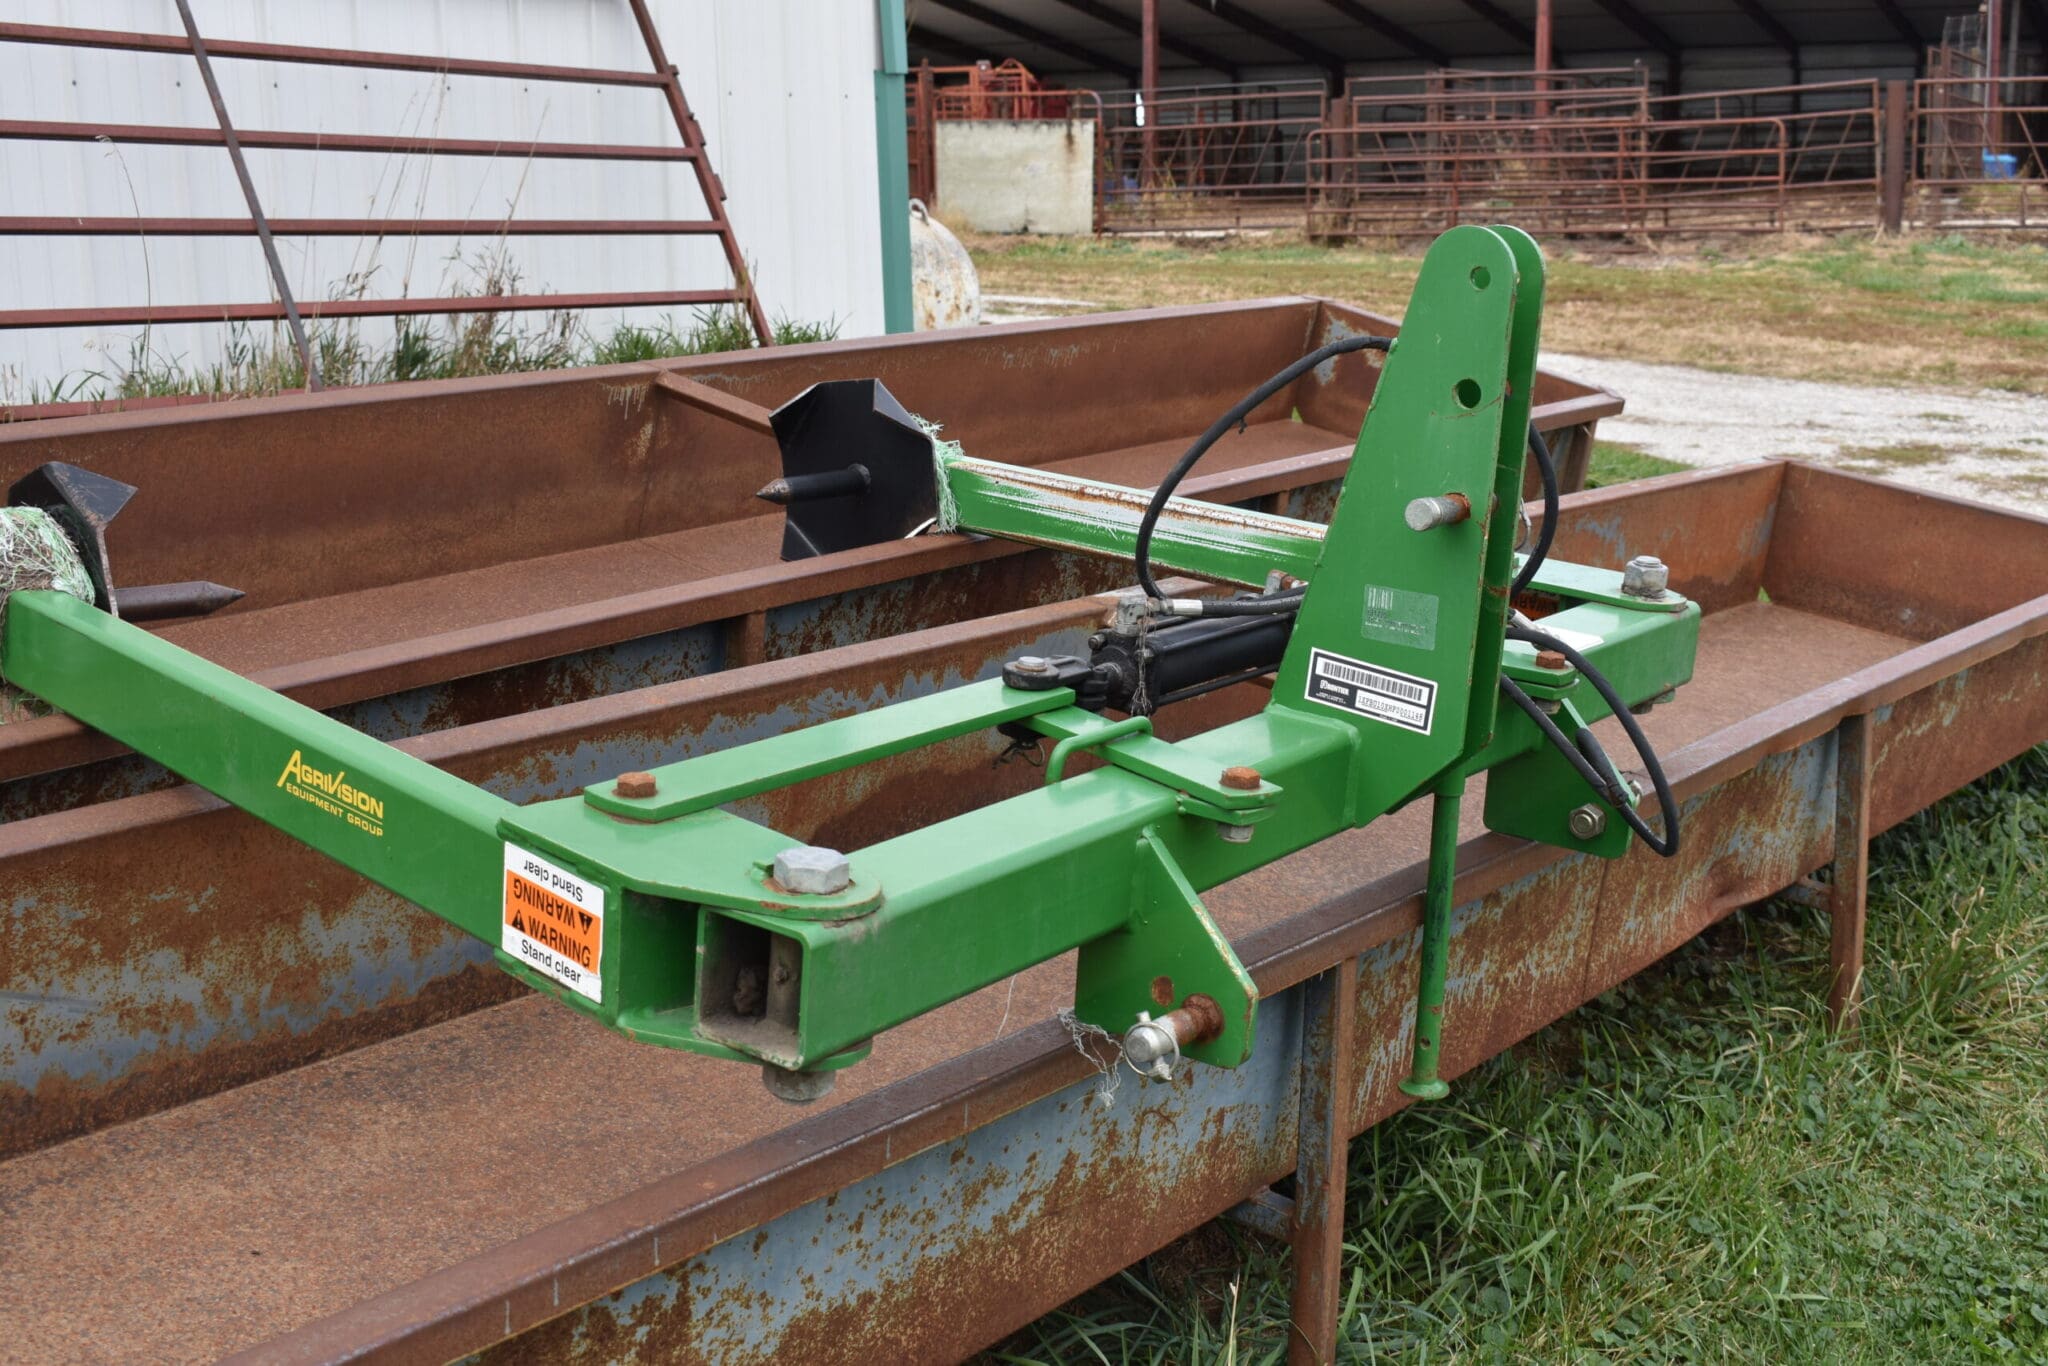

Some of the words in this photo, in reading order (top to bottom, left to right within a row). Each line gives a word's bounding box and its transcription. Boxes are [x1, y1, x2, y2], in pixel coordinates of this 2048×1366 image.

[286, 783, 343, 818] EQUIPMENT
[347, 813, 384, 837] GROUP
[524, 859, 549, 882] clear
[552, 874, 583, 902] Stand
[513, 878, 576, 929] WARNING
[521, 939, 552, 968] Stand
[555, 960, 582, 984] clear
[528, 915, 591, 968] WARNING
